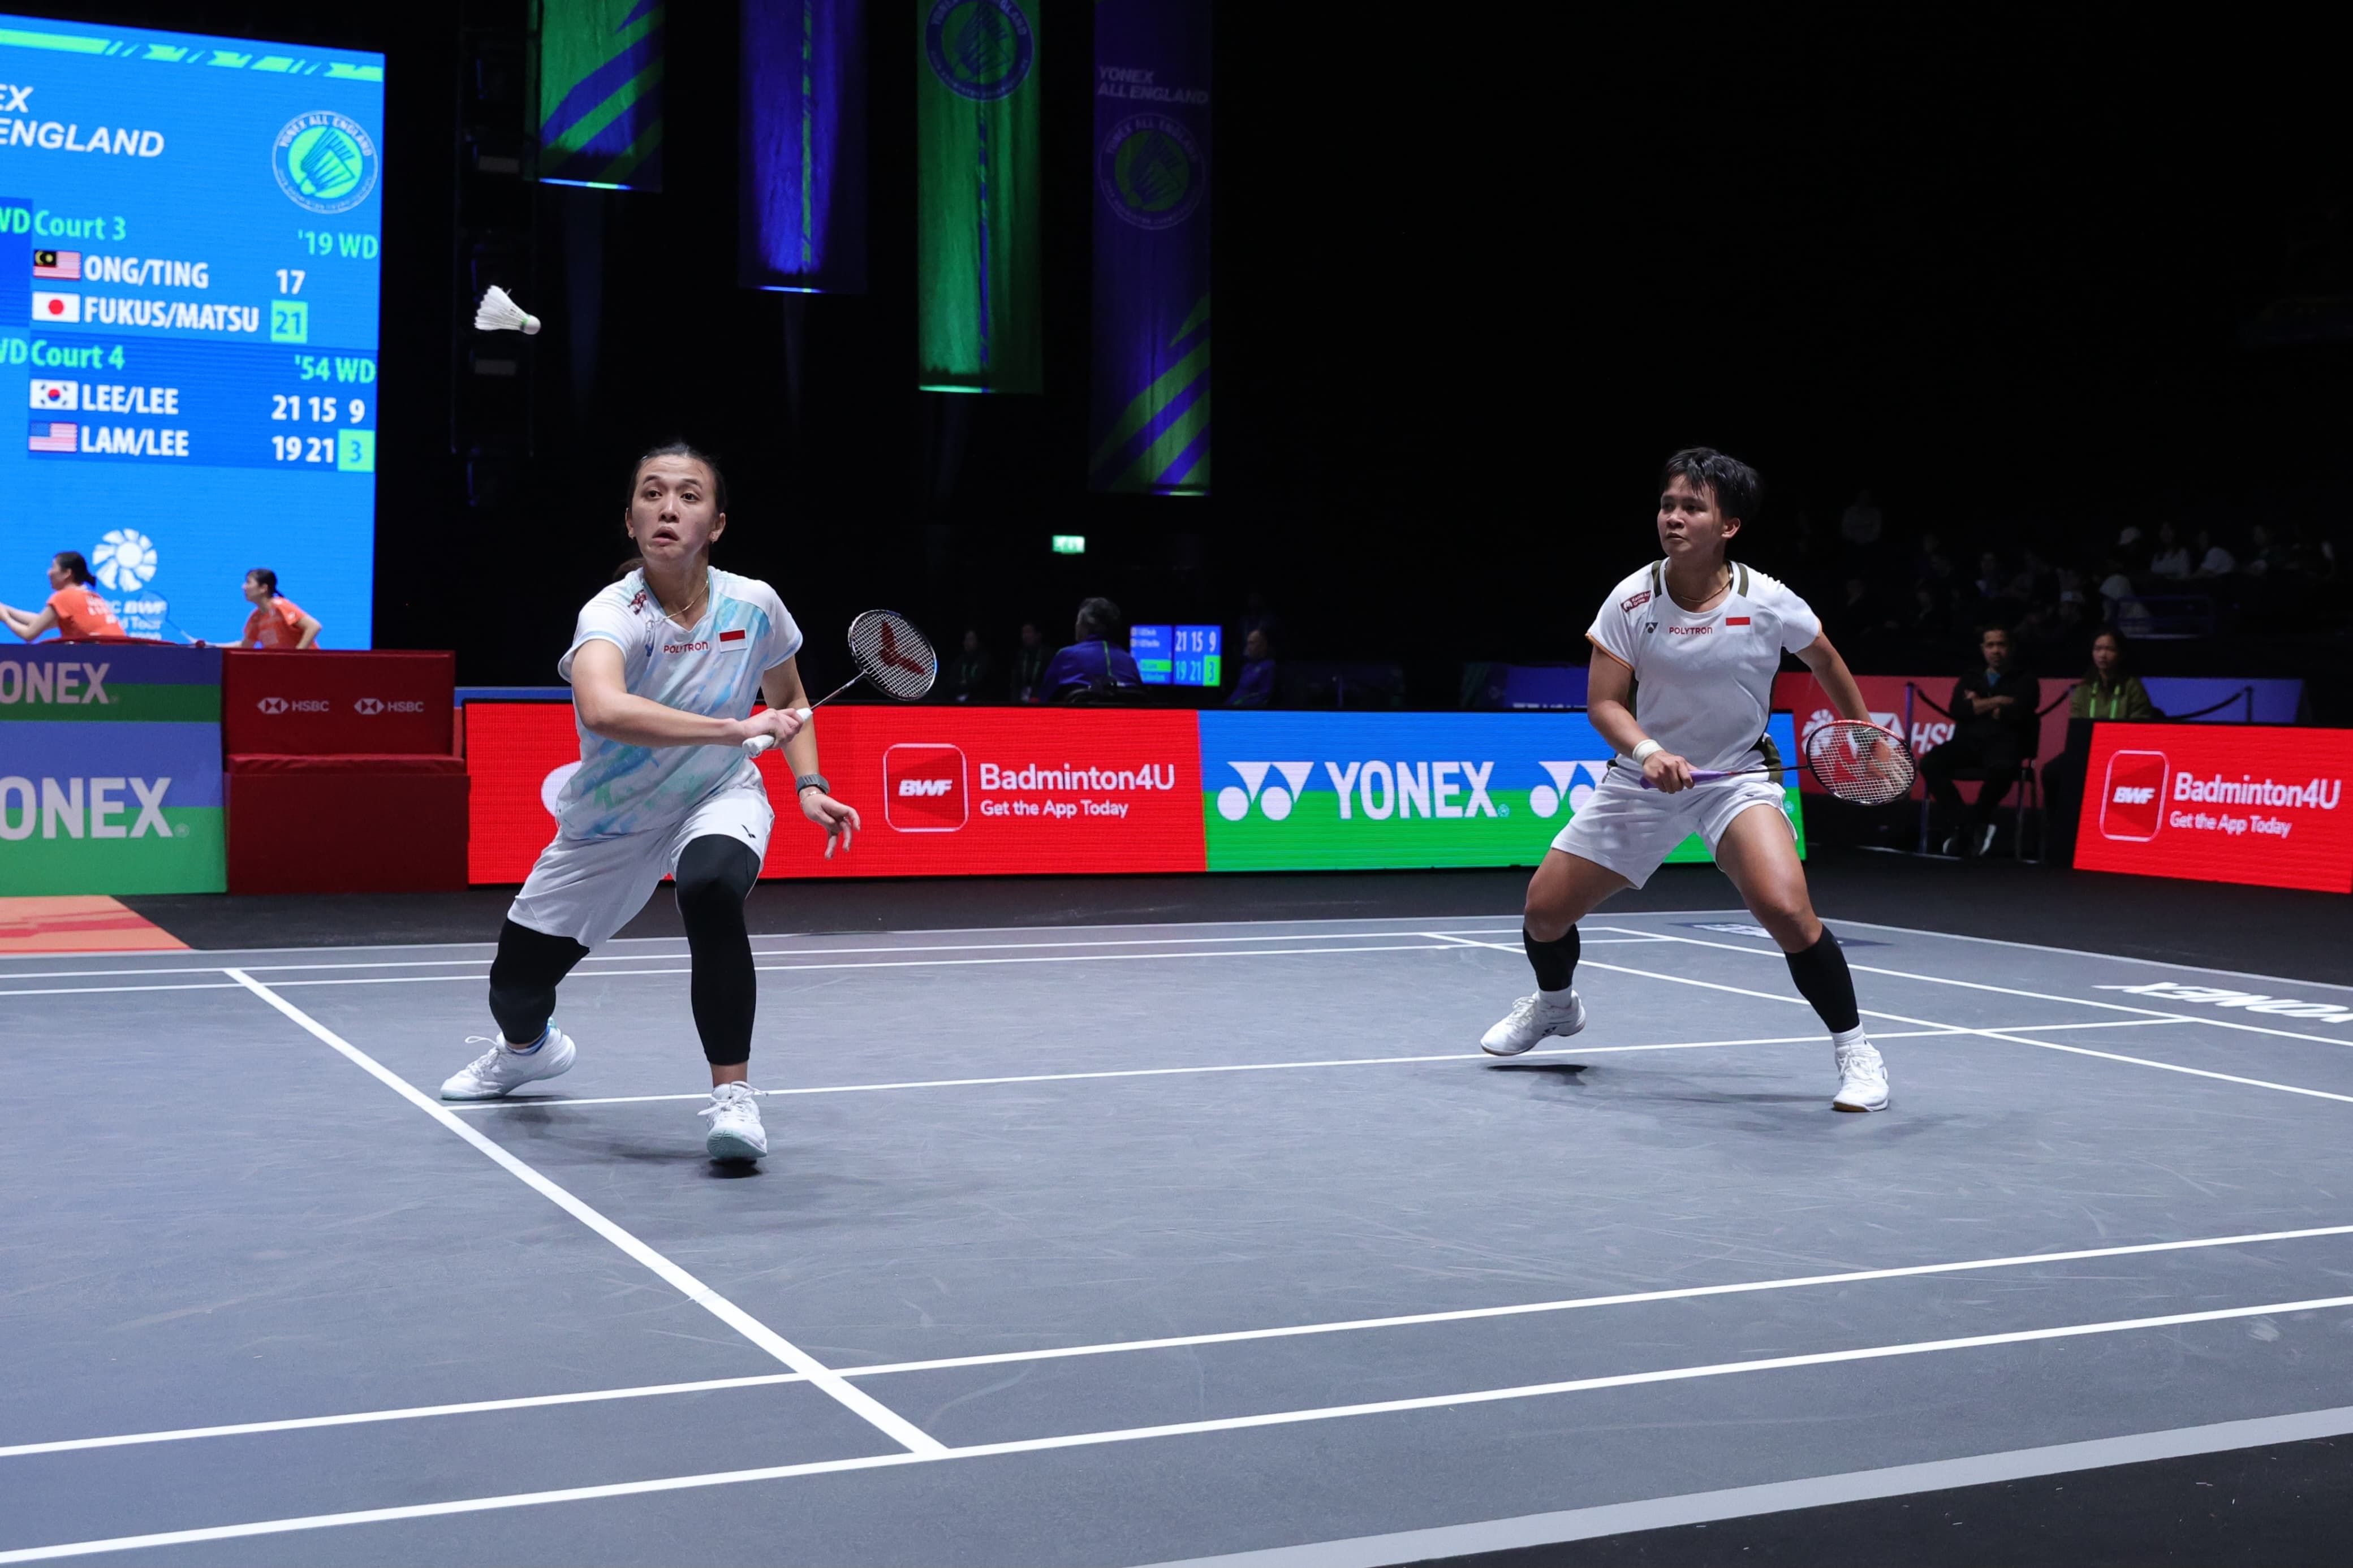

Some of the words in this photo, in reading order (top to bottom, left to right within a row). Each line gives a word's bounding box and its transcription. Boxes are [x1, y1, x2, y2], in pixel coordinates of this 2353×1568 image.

[1098, 65, 1155, 84] YONEX
[1097, 81, 1127, 98] ALL
[1129, 85, 1209, 105] ENGLAND
[35, 209, 106, 240] Court
[113, 215, 127, 241] 3
[298, 229, 333, 256] '19
[338, 232, 379, 260] WD
[84, 254, 209, 289] ONG/TING
[275, 269, 306, 295] 17
[84, 296, 260, 333] FUKUS/MATSU
[275, 311, 302, 335] 21
[31, 339, 104, 370] Court
[108, 344, 125, 371] 4
[294, 354, 331, 382] '54
[334, 357, 376, 384] WD
[82, 384, 179, 415] LEE/LEE
[271, 394, 300, 421] 21
[308, 396, 337, 422] 15
[348, 399, 365, 424] 9
[81, 425, 189, 457] LAM/LEE
[272, 435, 302, 461] 19
[305, 437, 334, 463] 21
[349, 440, 363, 464] 3
[1175, 630, 1187, 652] 21
[1191, 631, 1203, 653] 15
[1209, 631, 1216, 653] 9
[1669, 627, 1713, 635] POLYTRON
[0, 660, 110, 704] ONEX
[1176, 660, 1187, 681] 19
[1190, 660, 1201, 681] 21
[1209, 660, 1216, 683] 3
[291, 701, 330, 712] HSBC
[387, 701, 424, 712] HSBC
[898, 779, 953, 797] BWF
[980, 763, 1175, 791] Badminton4U
[1324, 760, 1498, 820] YONEX
[2173, 771, 2342, 809] Badminton4U
[0, 776, 174, 841] ONEX
[980, 800, 1010, 816] Get
[1012, 799, 1039, 816] the
[1042, 800, 1078, 819] App
[1079, 800, 1128, 818] Today
[2169, 811, 2194, 828] Get
[2195, 813, 2216, 830] the
[2216, 813, 2248, 836] App
[2249, 815, 2292, 839] Today
